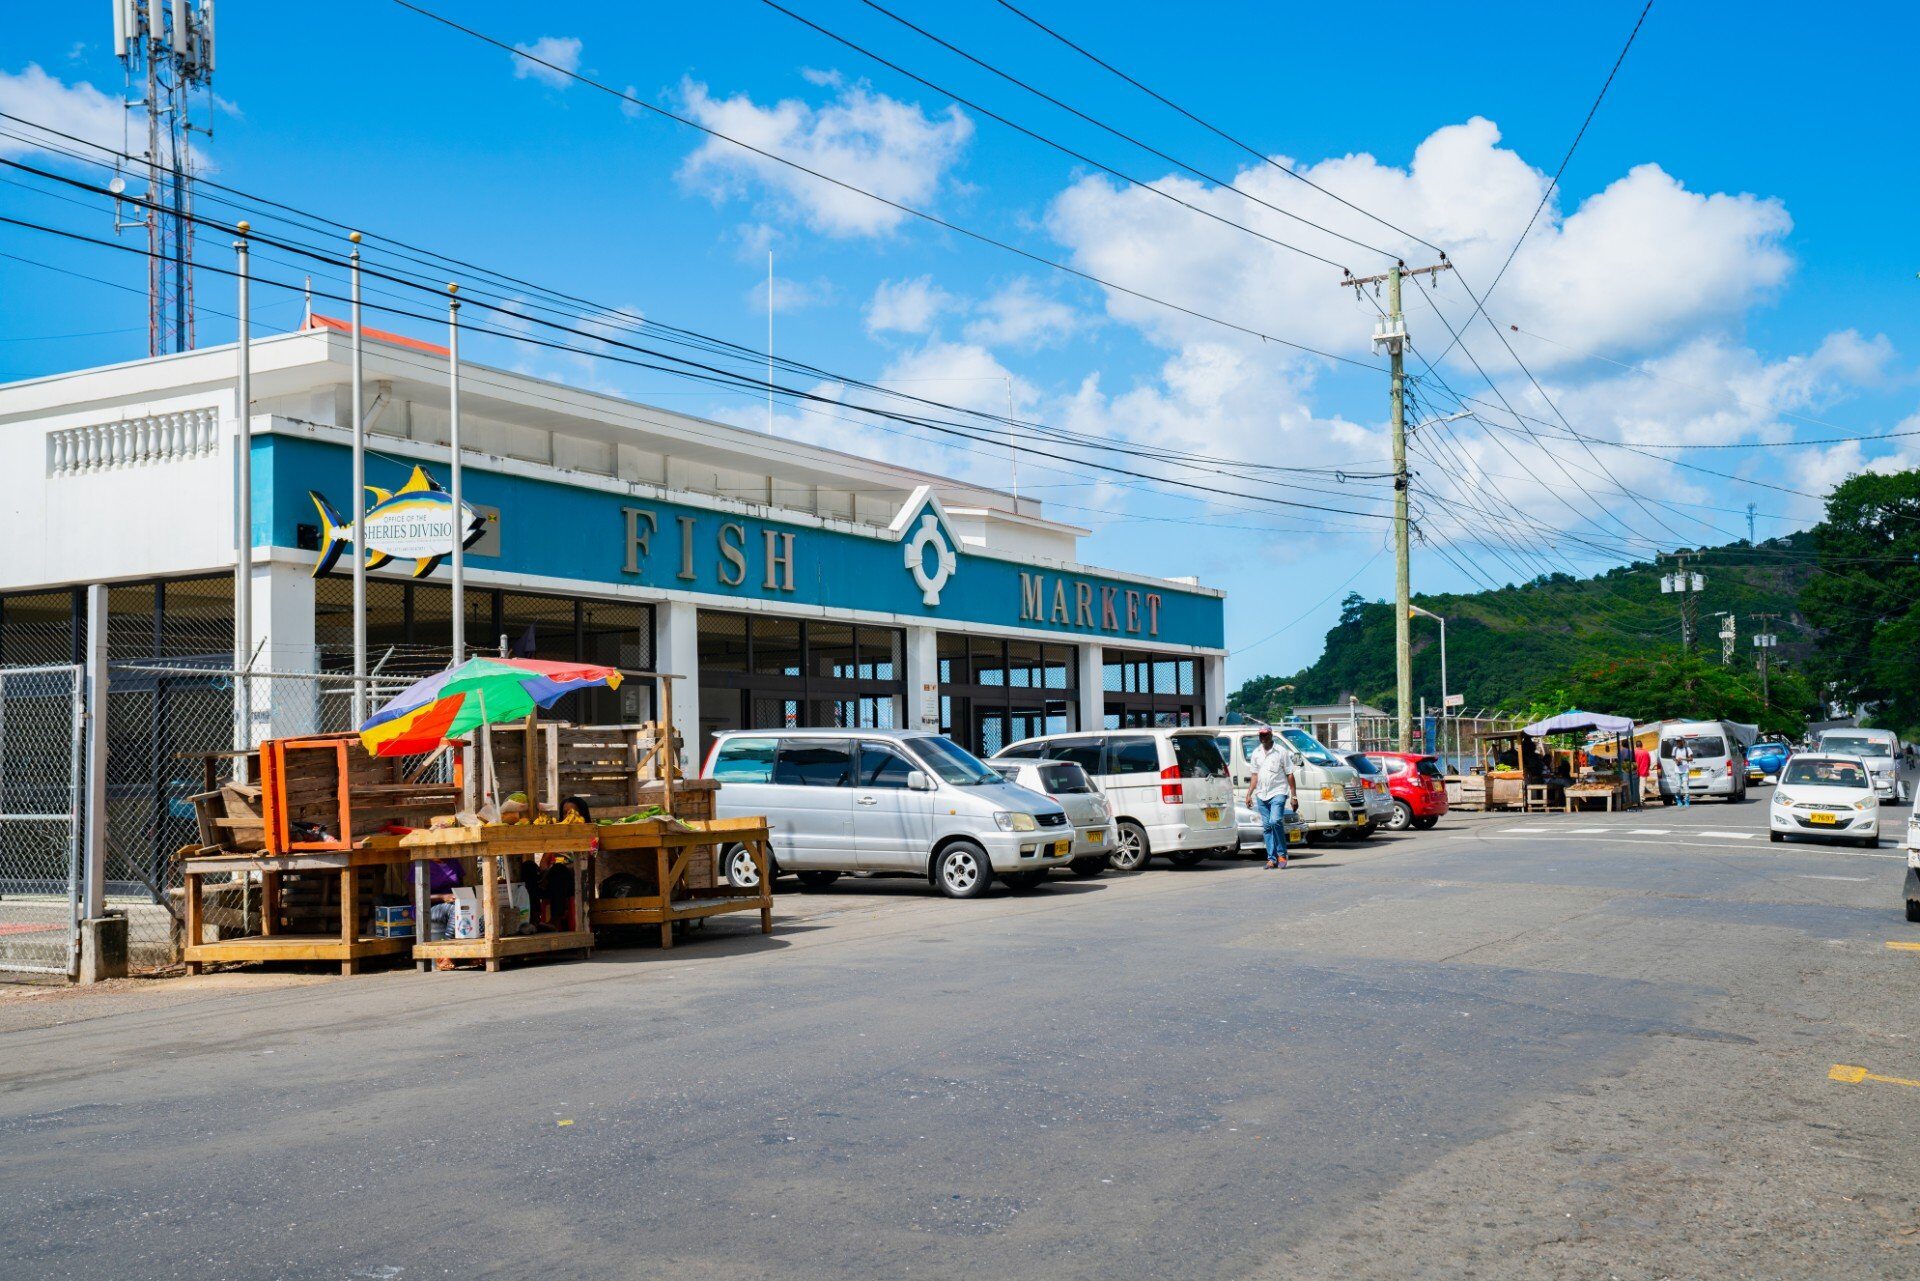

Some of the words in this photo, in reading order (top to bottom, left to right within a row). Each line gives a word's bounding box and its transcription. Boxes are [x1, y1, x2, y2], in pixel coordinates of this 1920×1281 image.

[384, 515, 405, 523] OFFICE
[417, 513, 427, 521] THE
[409, 522, 452, 538] DIVISIO
[620, 506, 796, 592] FISH
[1019, 572, 1161, 635] MARKET
